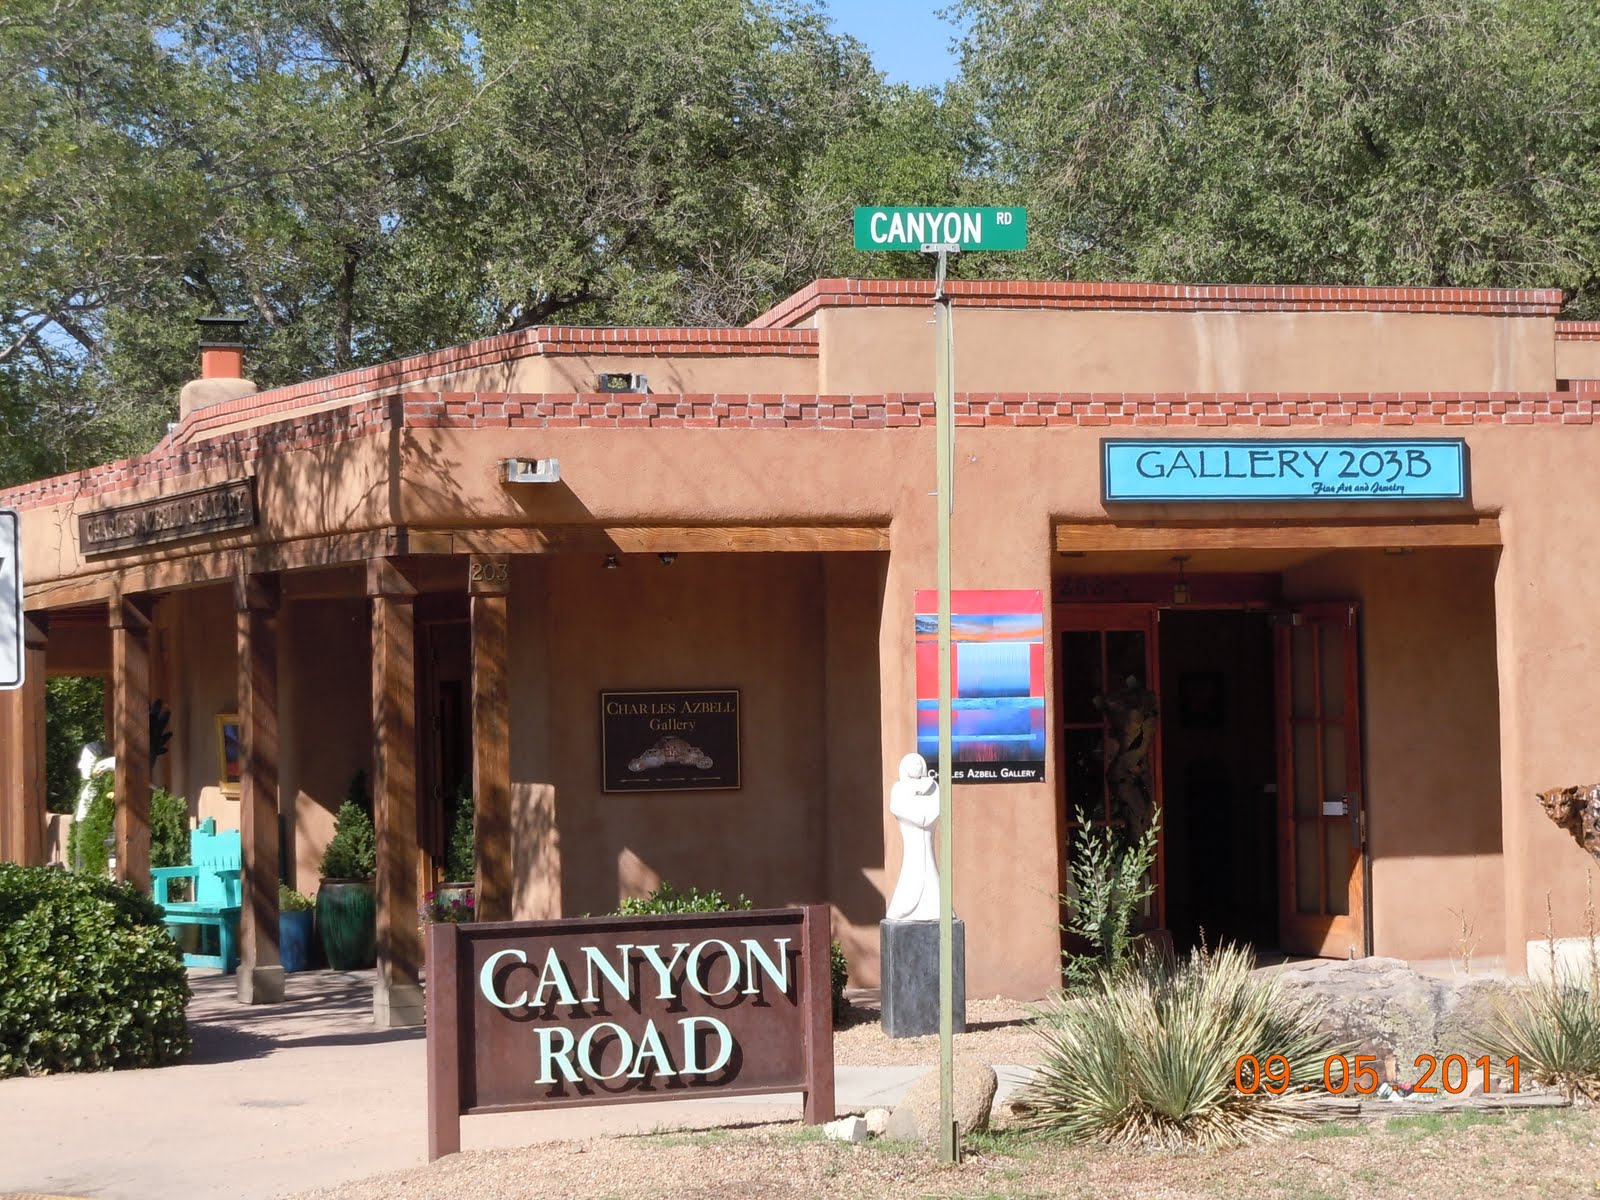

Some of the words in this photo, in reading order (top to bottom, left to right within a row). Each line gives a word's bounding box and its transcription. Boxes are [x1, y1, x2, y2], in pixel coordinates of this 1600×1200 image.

[870, 211, 982, 244] CANYON
[996, 211, 1013, 225] RD
[1136, 449, 1329, 479] GALLERY
[1337, 449, 1432, 482] 203B
[1311, 481, 1335, 494] Fine
[1336, 482, 1352, 493] Art
[1354, 482, 1369, 492] and
[1370, 481, 1405, 495] Jewelry
[471, 563, 508, 581] 203
[606, 701, 676, 716] CHARLES
[681, 701, 736, 714] AZBELL
[649, 718, 697, 731] Gallery
[927, 769, 964, 779] CHES
[967, 768, 998, 779] AZBELL
[1000, 767, 1036, 778] GALLERY
[480, 937, 792, 1009] CANYON
[533, 1016, 733, 1085] ROAD
